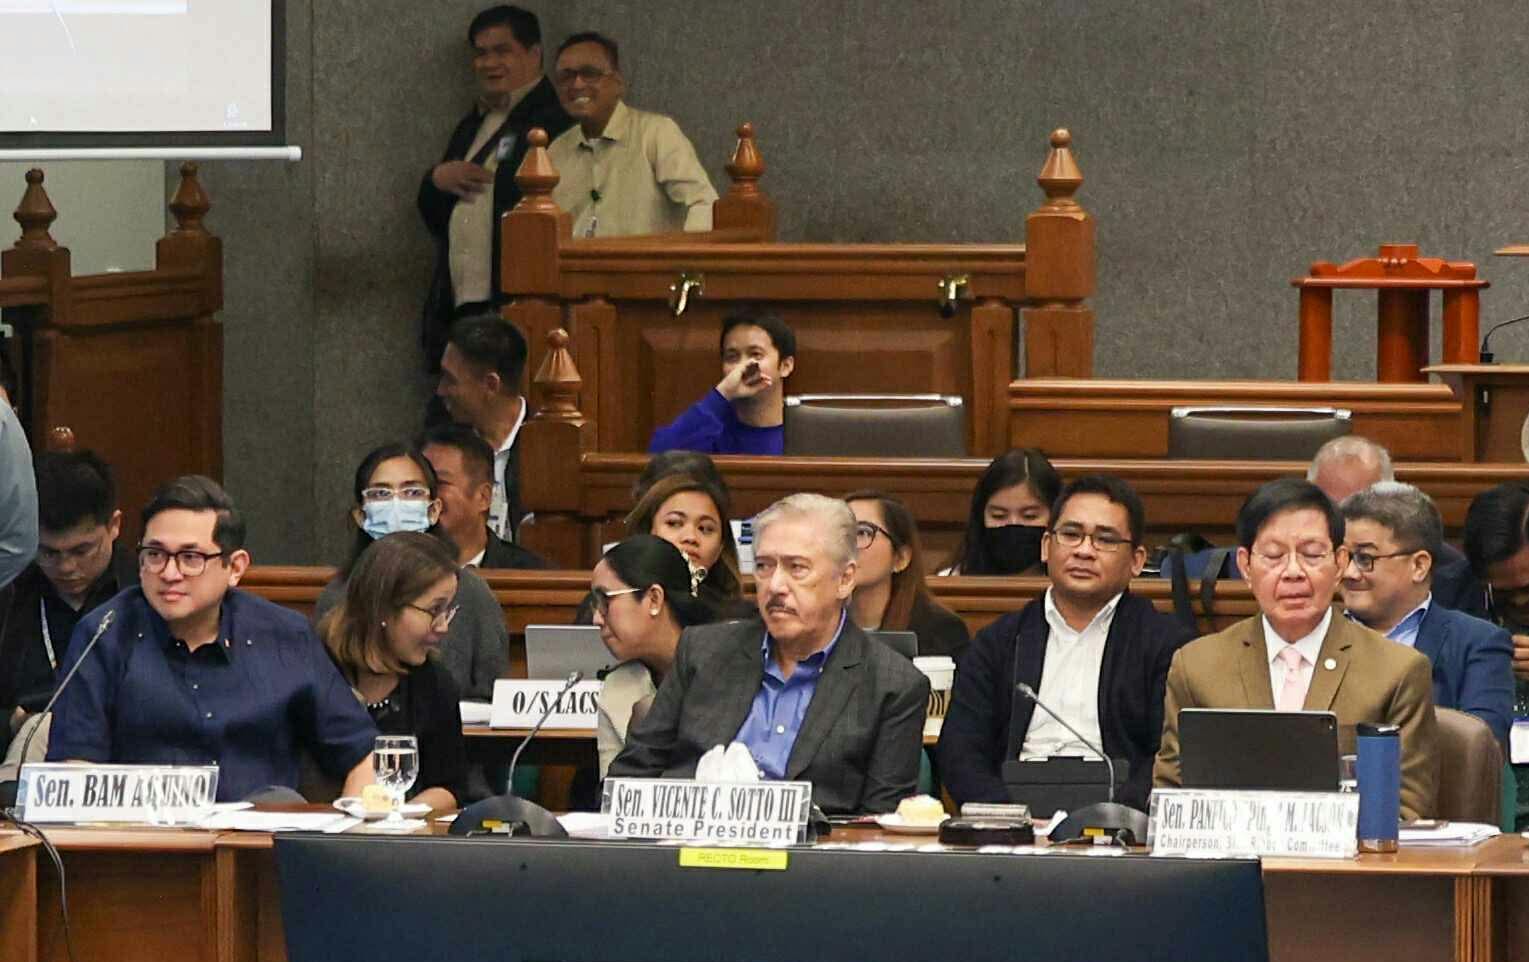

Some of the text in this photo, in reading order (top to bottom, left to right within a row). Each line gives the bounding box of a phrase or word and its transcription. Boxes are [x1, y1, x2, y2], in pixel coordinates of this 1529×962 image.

[34, 774, 74, 807] Sen.
[82, 774, 128, 808] BAM
[616, 784, 798, 823] Sen. VICENTE C. SOTTO III
[614, 817, 792, 840] Senate President
[1161, 798, 1185, 830] Sen.
